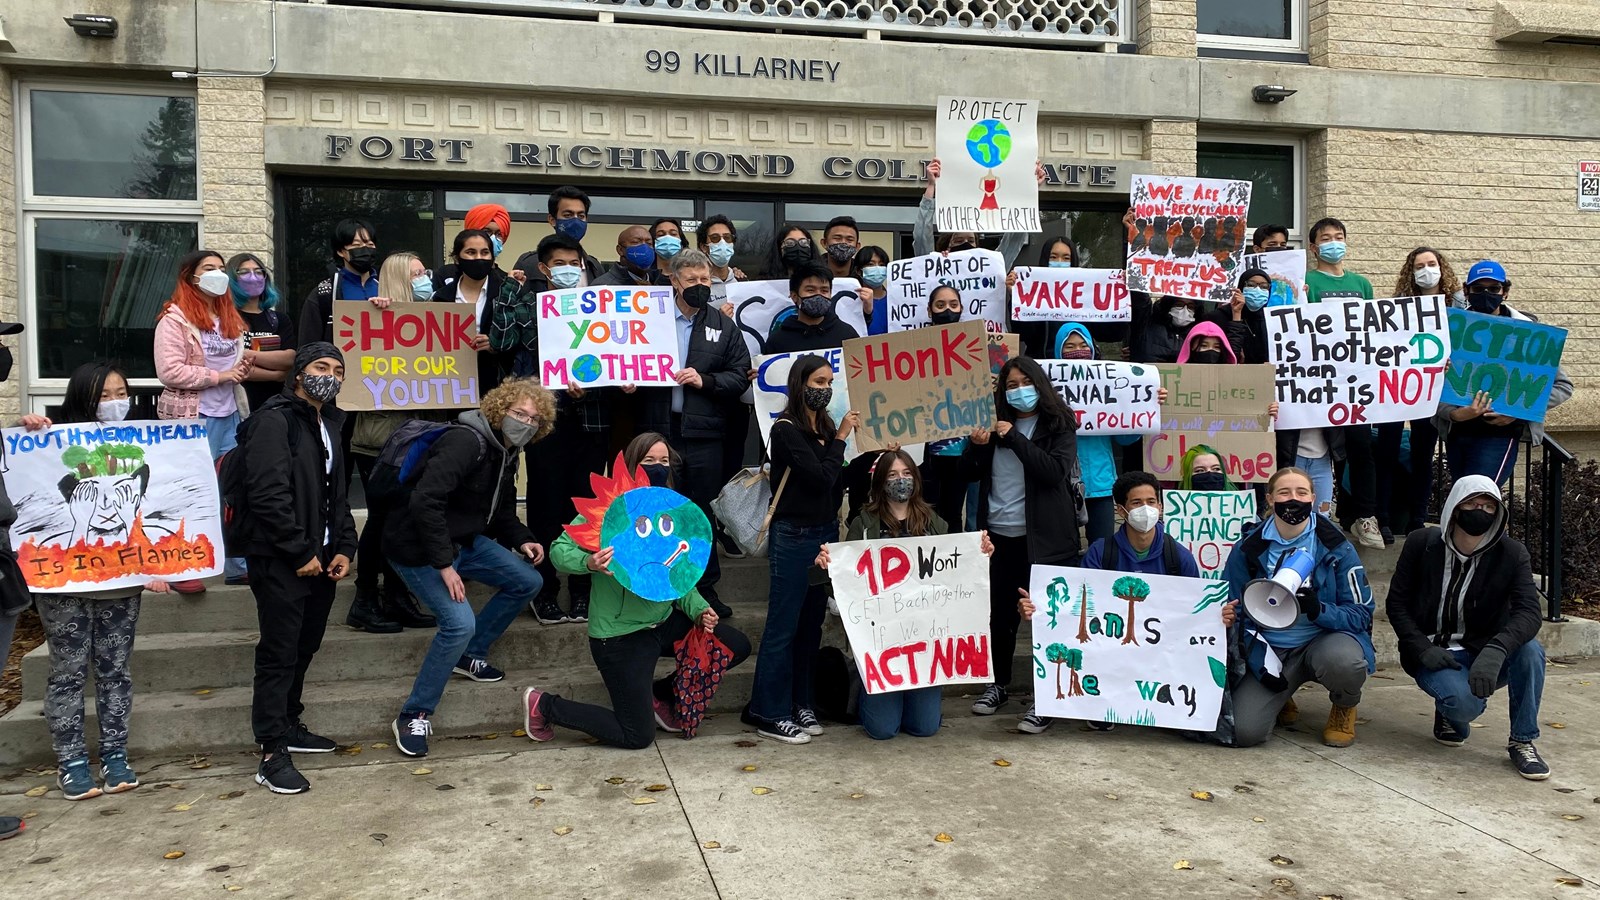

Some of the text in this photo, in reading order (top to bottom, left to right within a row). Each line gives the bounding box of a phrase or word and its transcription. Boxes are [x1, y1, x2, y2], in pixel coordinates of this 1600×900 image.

[645, 50, 841, 83] 99 KILLARNEY
[948, 99, 1027, 122] PROTECT
[326, 135, 1118, 186] FORT RICHMOND COLATE
[1148, 182, 1220, 202] WE ARE
[1583, 179, 1598, 190] 24
[938, 206, 1038, 231] MOTHER EARTH
[1135, 203, 1246, 219] NON-RECYCLABLE
[891, 257, 990, 281] BE PART OF
[1132, 258, 1227, 284] TREAT US
[900, 282, 926, 299] THE
[1016, 280, 1129, 311] WAKE UP
[1149, 276, 1213, 298] LIKE IT
[541, 289, 670, 319] RESPECT
[891, 298, 987, 321] NOT OF
[1271, 296, 1441, 334] The EARTH
[361, 310, 478, 352] HONK
[567, 319, 650, 349] YOUR
[1448, 313, 1567, 368] ACTION
[1274, 332, 1301, 362] is
[1311, 331, 1409, 367] hotter
[361, 355, 459, 376] FOR OUR
[543, 353, 677, 387] MOTHER
[1040, 363, 1117, 383] LIMATE
[1276, 363, 1337, 379] than
[362, 376, 478, 409] YOUTH
[1053, 383, 1154, 406] ENIAL IS
[1159, 365, 1255, 411] The places
[1275, 367, 1443, 406] That is NOT
[865, 388, 995, 440] for change
[1085, 421, 1094, 430] a
[1097, 410, 1156, 430] POLICY
[1327, 402, 1368, 426] OK
[7, 427, 81, 455] YOUTH
[147, 423, 208, 445] HEALTH
[1165, 491, 1254, 517] SYSTEM
[30, 545, 206, 577] Is In Flames
[854, 544, 962, 597] 1D Wont
[848, 583, 975, 624] GET Back Together
[1189, 636, 1216, 646] are
[864, 634, 989, 694] ACT NOW
[1045, 642, 1197, 718] The way
